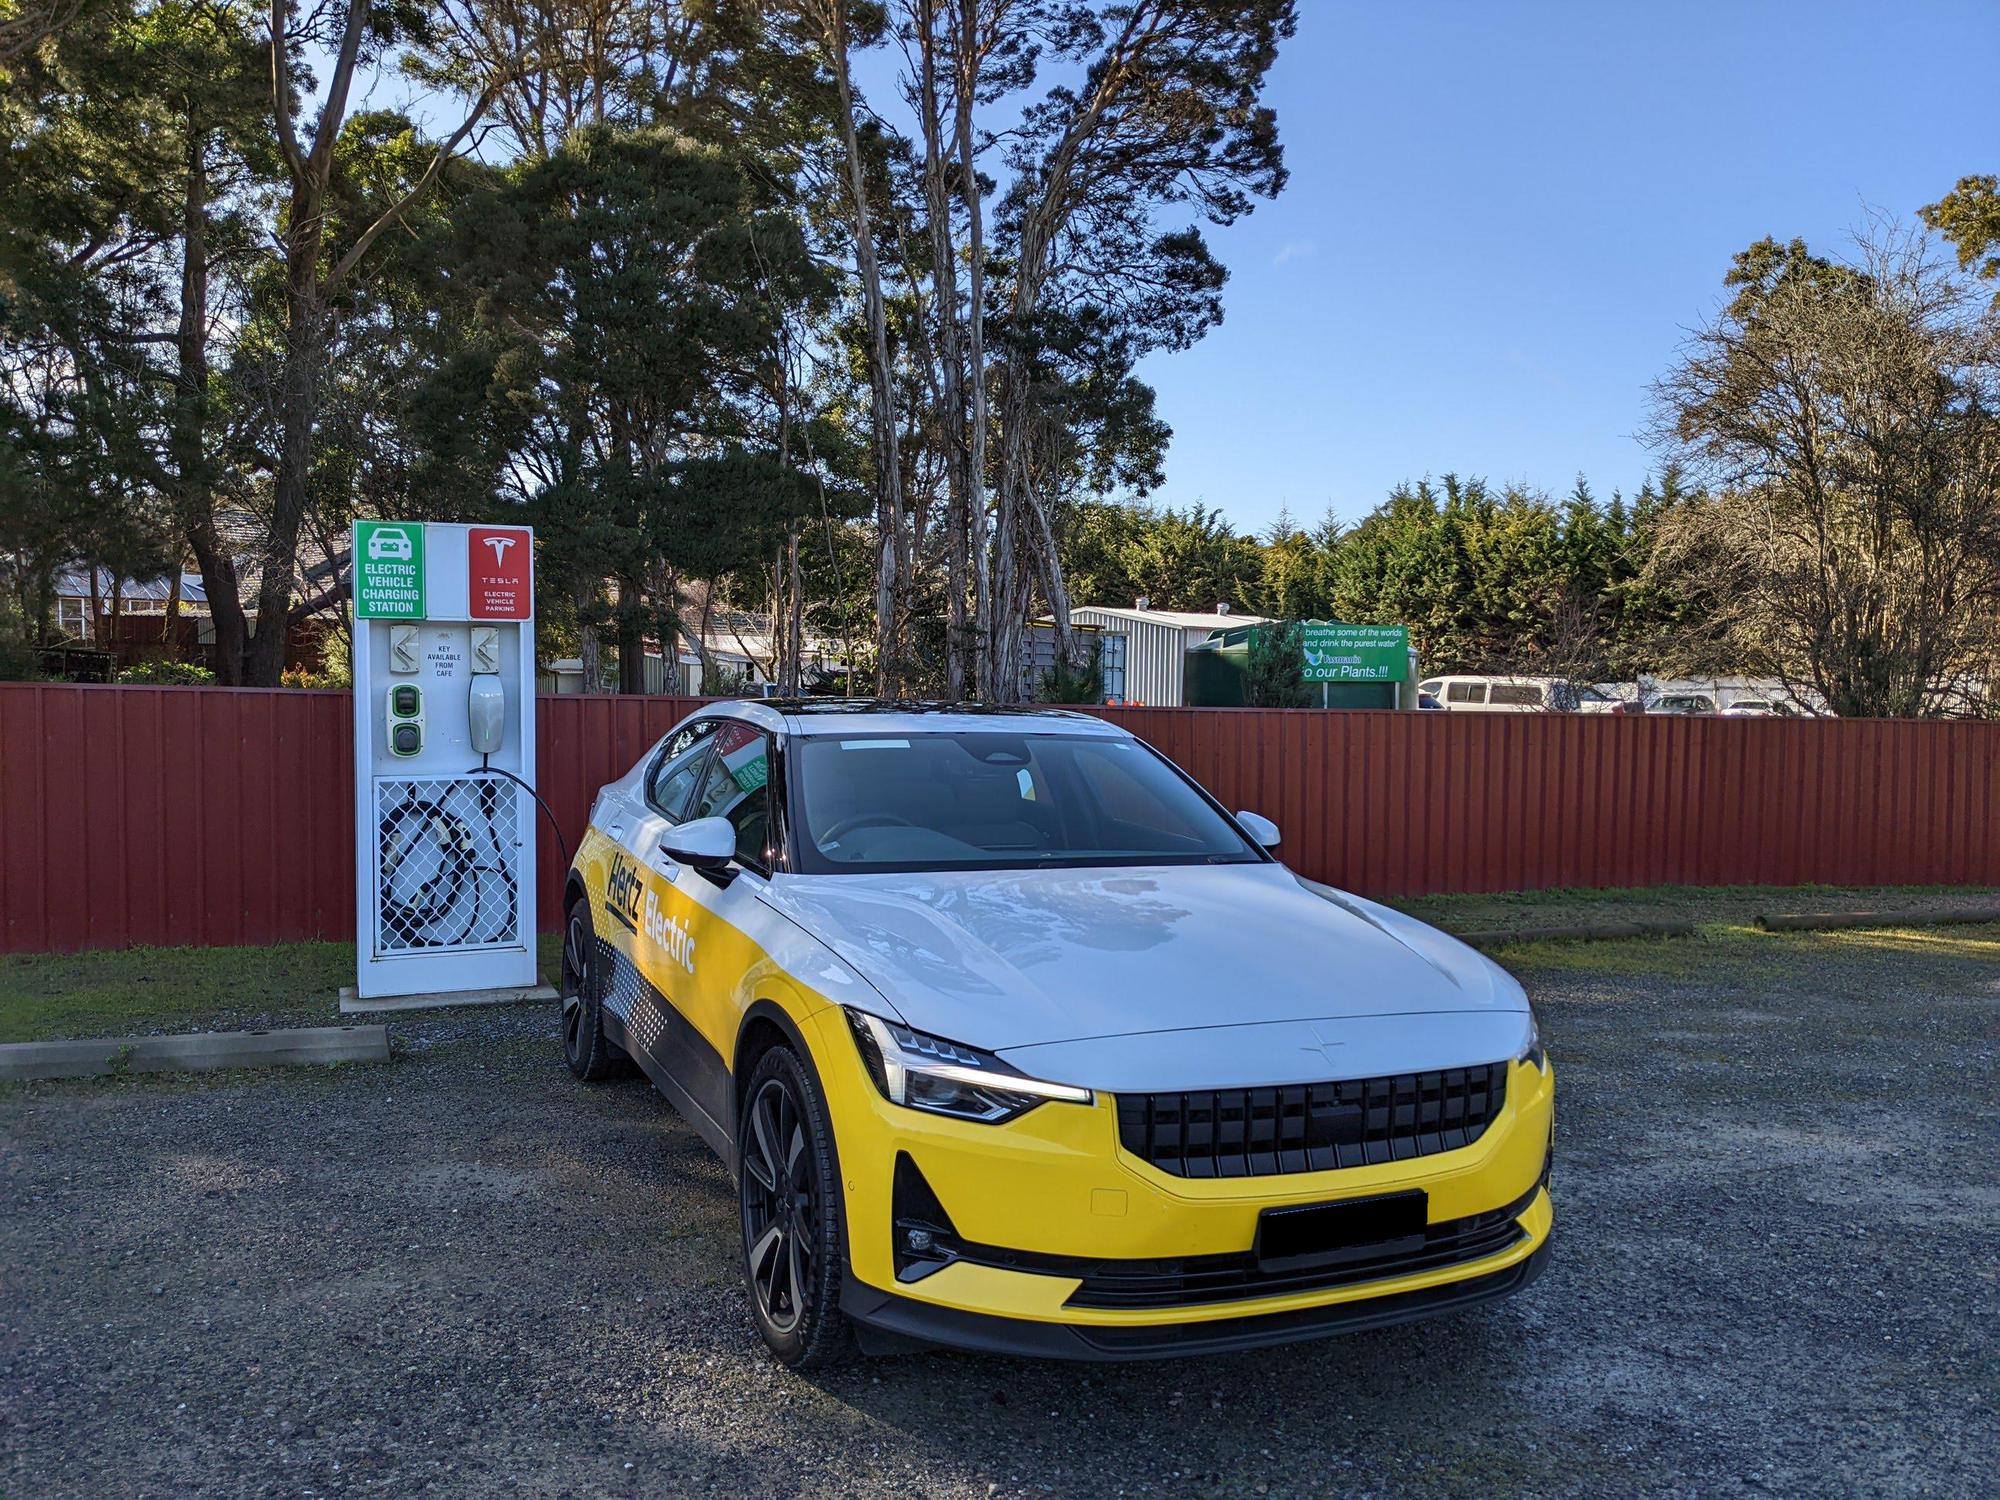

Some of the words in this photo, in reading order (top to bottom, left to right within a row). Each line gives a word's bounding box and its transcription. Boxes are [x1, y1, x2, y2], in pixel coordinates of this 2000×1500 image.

[365, 563, 416, 575] ELECTRIC
[368, 576, 414, 588] VEHICLE
[362, 588, 419, 601] CHARGING
[368, 601, 414, 613] STATION
[1305, 628, 1335, 637] breathe
[1359, 628, 1368, 636] of
[1367, 628, 1379, 636] the
[1380, 629, 1402, 637] worlds
[1303, 639, 1318, 647] and
[1320, 639, 1339, 647] drink
[1341, 639, 1353, 647] the
[1353, 640, 1377, 648] purest
[1316, 668, 1338, 678] our
[607, 851, 643, 922] Hertz
[644, 888, 696, 974] Electric
